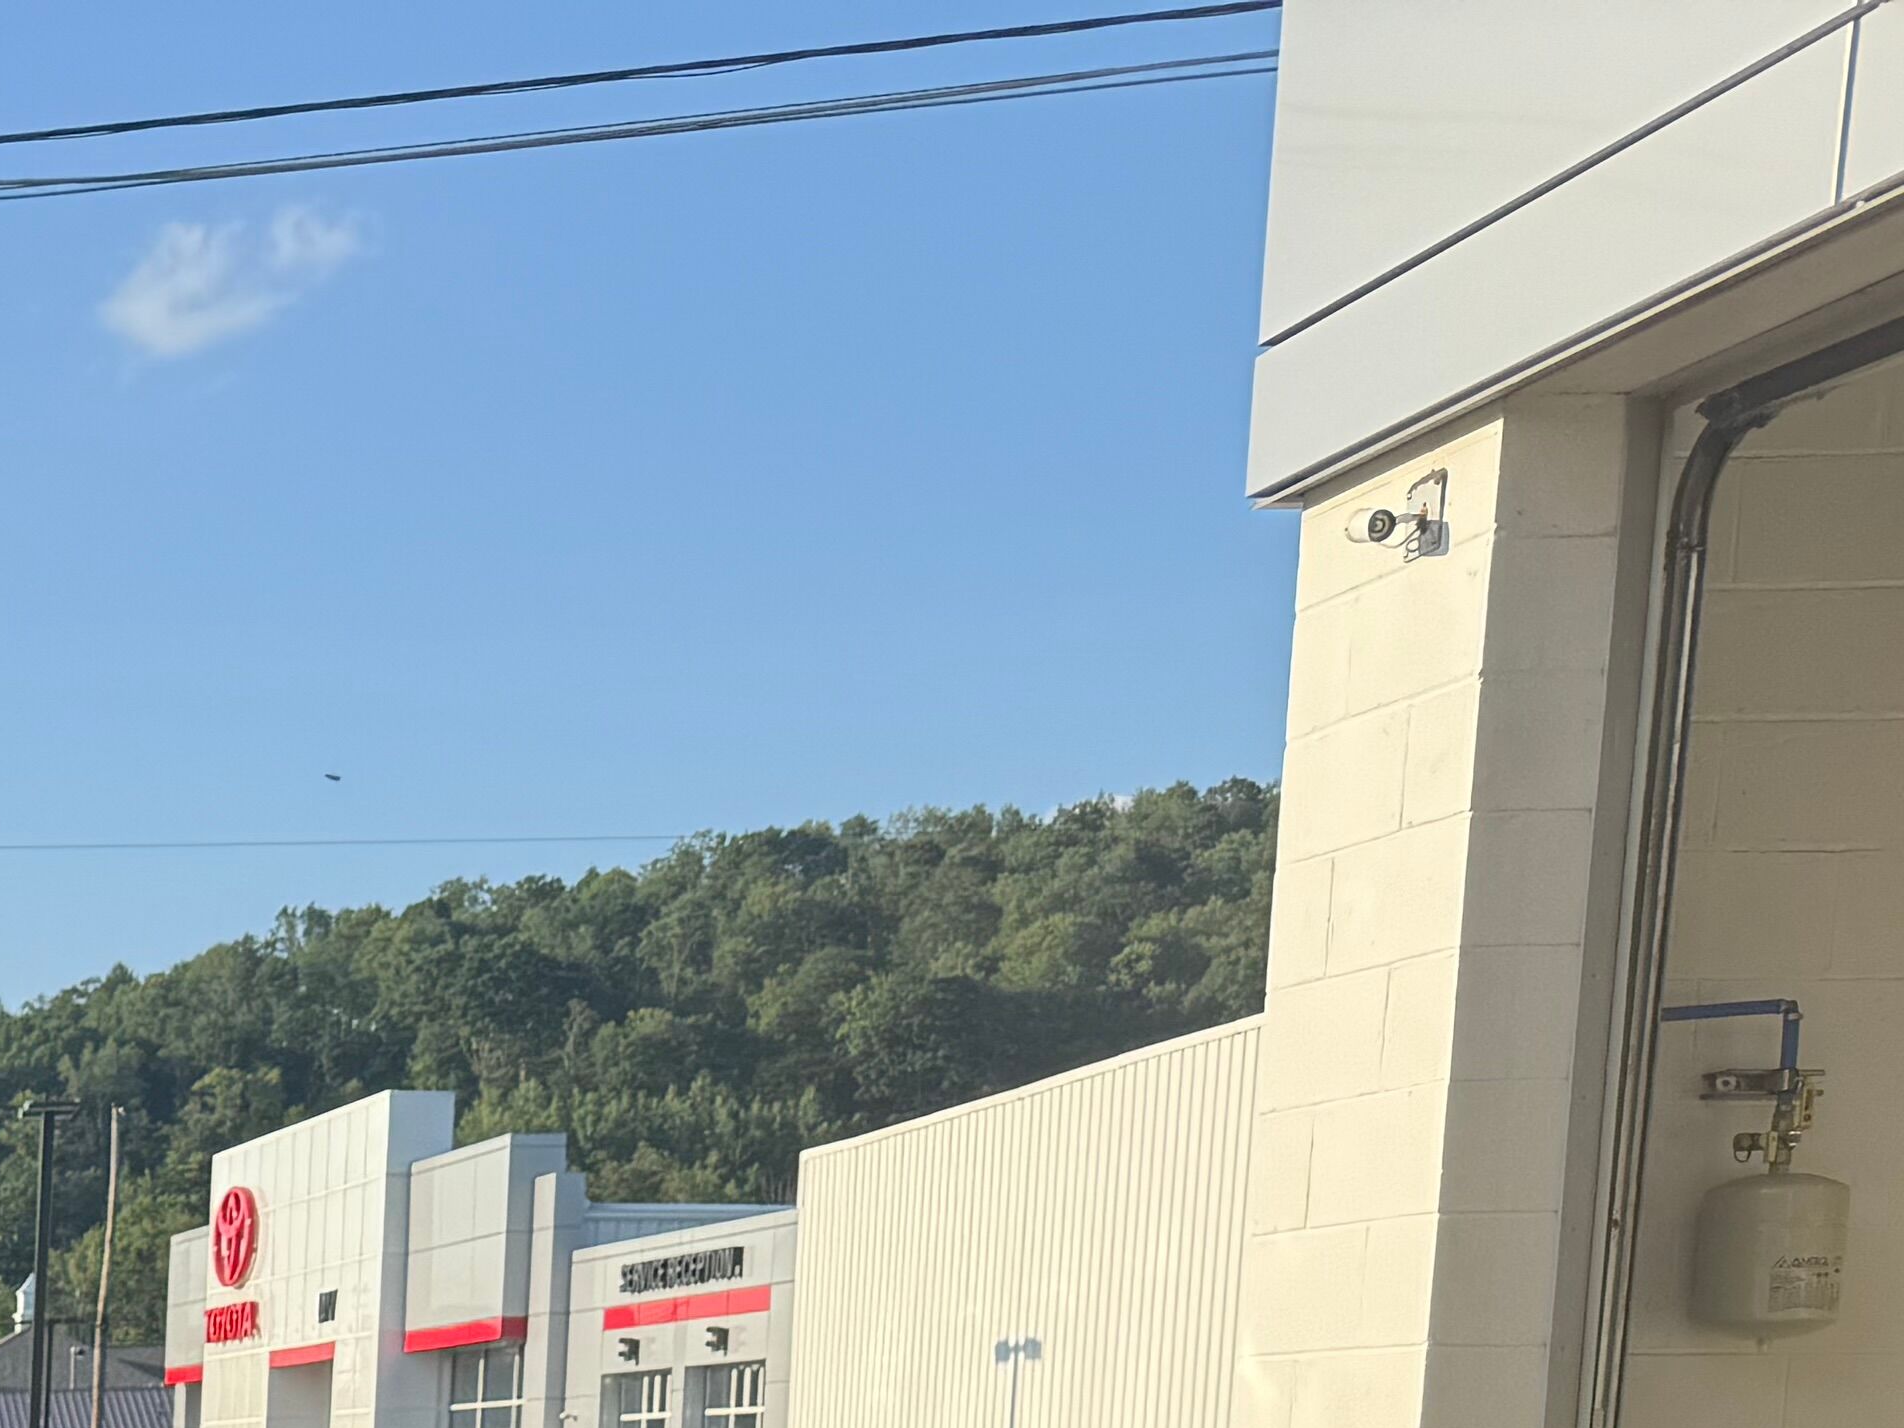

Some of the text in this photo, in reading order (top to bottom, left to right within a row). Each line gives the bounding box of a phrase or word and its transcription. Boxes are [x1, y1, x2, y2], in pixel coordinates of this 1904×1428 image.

[620, 1247, 743, 1293] SERVICE RECEPTION
[203, 1301, 259, 1344] TOYOTA
